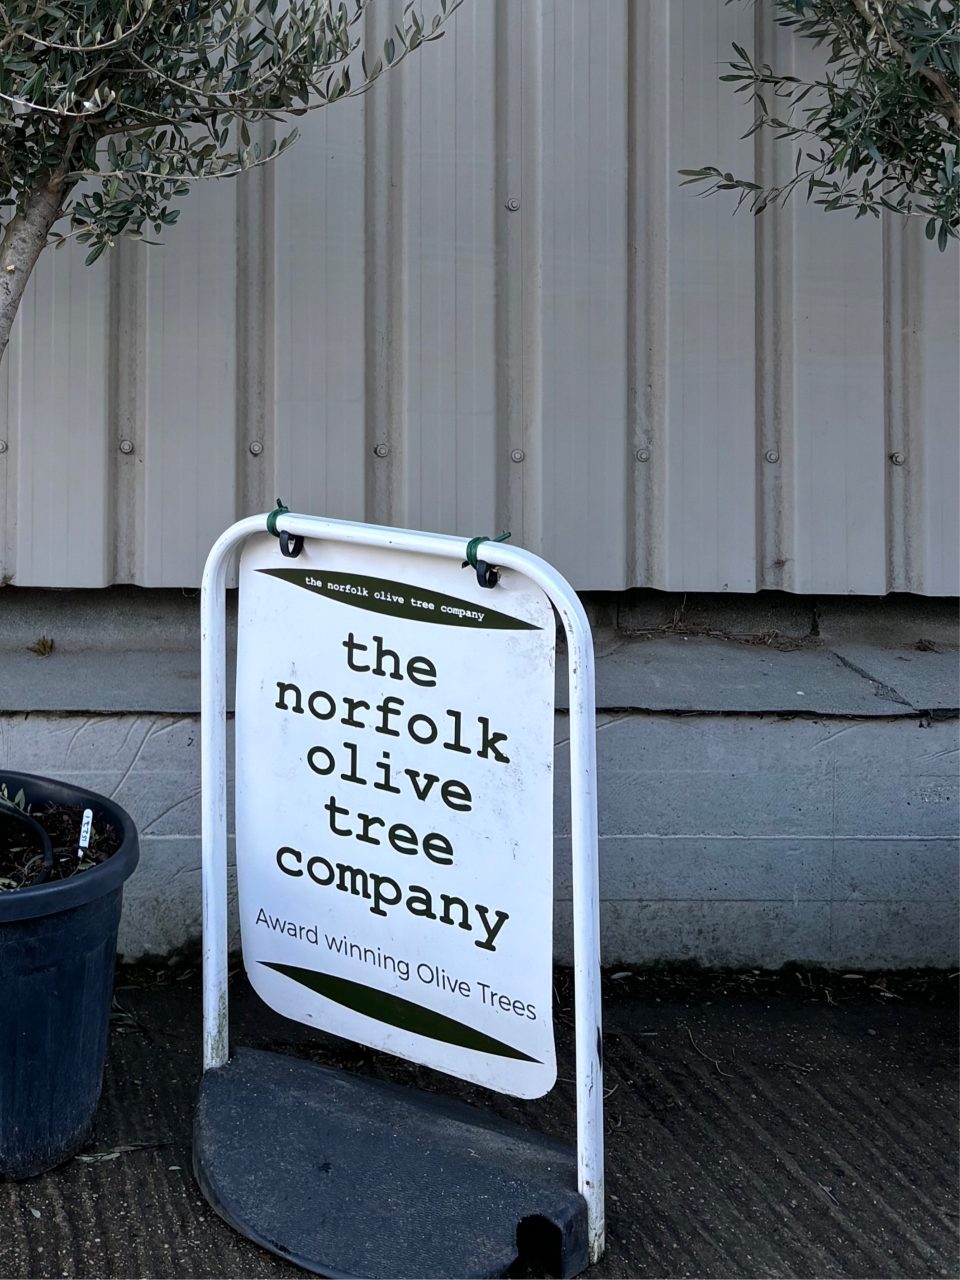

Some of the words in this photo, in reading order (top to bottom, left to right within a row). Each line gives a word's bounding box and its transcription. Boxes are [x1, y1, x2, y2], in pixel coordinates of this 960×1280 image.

[305, 576, 323, 588] the
[327, 582, 369, 597] norfolk
[373, 590, 405, 604] olive
[410, 597, 435, 610] tree
[440, 604, 485, 622] company
[342, 632, 437, 688] the
[275, 681, 511, 764] norfolk
[306, 741, 472, 812] olive
[324, 795, 454, 866] tree
[276, 846, 510, 952] company
[255, 907, 319, 946] Award
[324, 932, 410, 981] winning
[416, 962, 471, 999] Olive
[476, 981, 537, 1021] Trees
